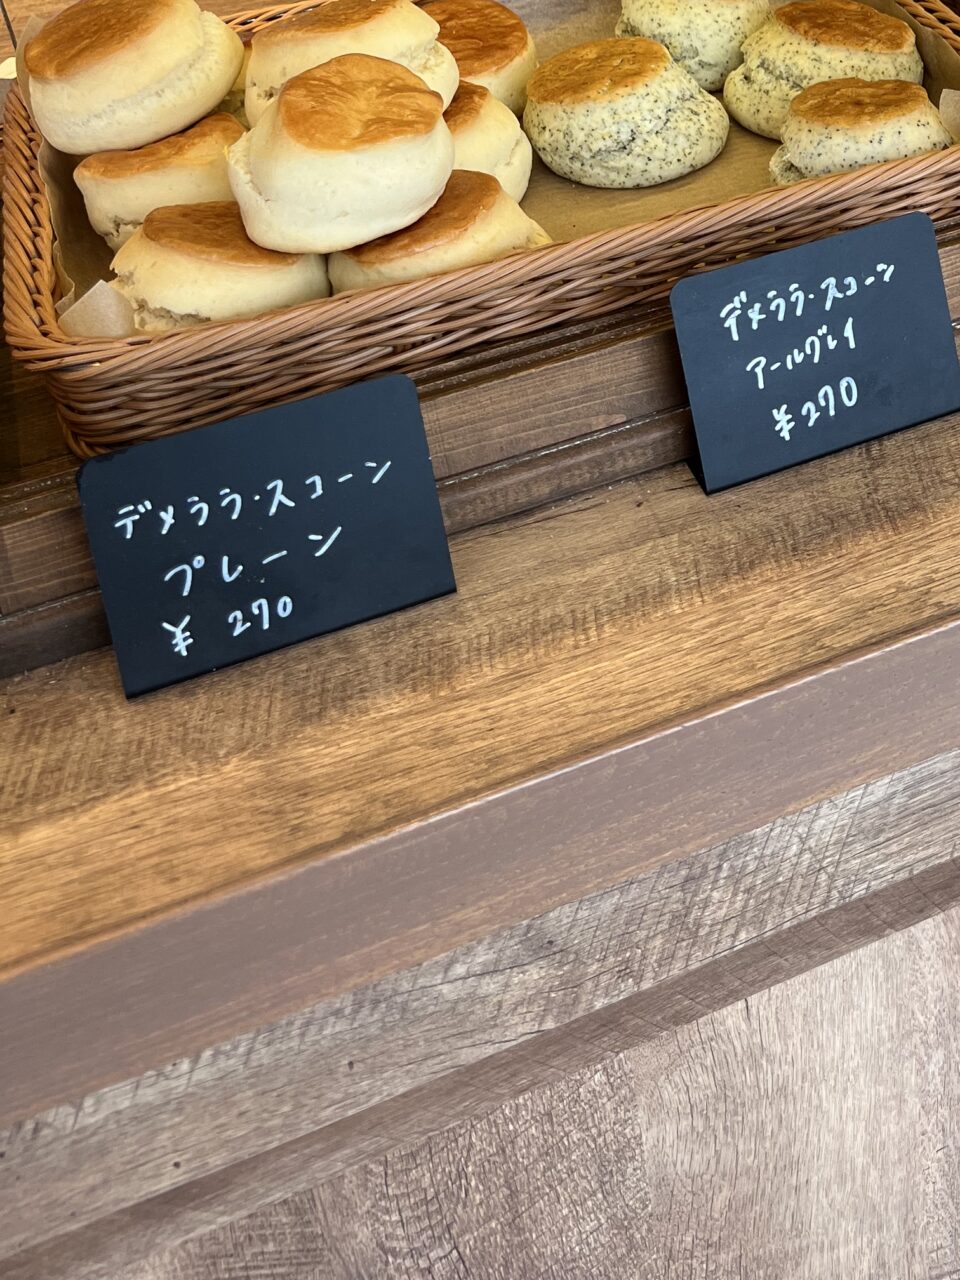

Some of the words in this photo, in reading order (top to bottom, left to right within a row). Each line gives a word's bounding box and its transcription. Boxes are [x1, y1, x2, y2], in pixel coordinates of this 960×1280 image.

[746, 317, 856, 389] アールグレイ
[772, 377, 858, 441] ¥270
[164, 526, 342, 596] プレーン
